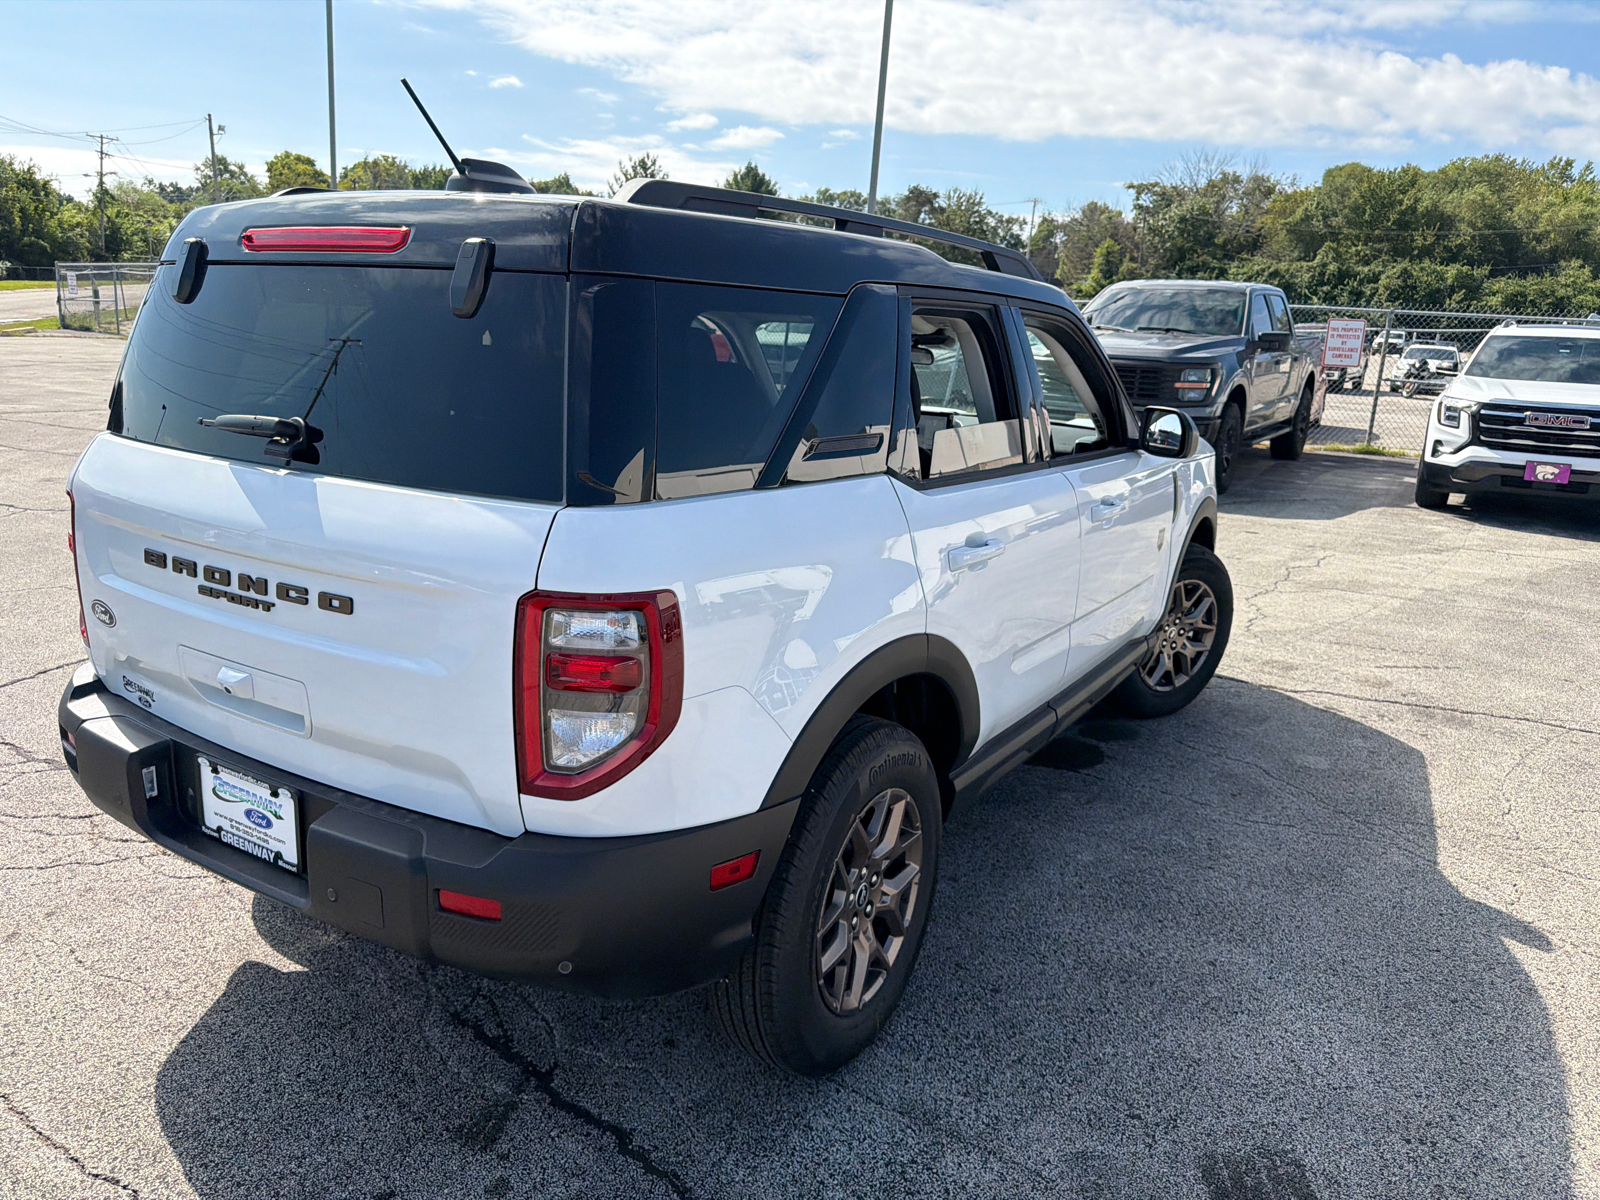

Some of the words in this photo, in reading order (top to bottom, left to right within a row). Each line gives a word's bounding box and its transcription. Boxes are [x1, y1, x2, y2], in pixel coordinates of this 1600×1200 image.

[1529, 413, 1586, 427] GMC
[143, 547, 354, 615] BRONCO
[197, 584, 275, 612] SPORT
[869, 751, 917, 786] Continental
[212, 775, 284, 818] GREENWAY
[213, 810, 287, 846] www.greenwayfordkc.com
[220, 831, 275, 863] GREENWAY
